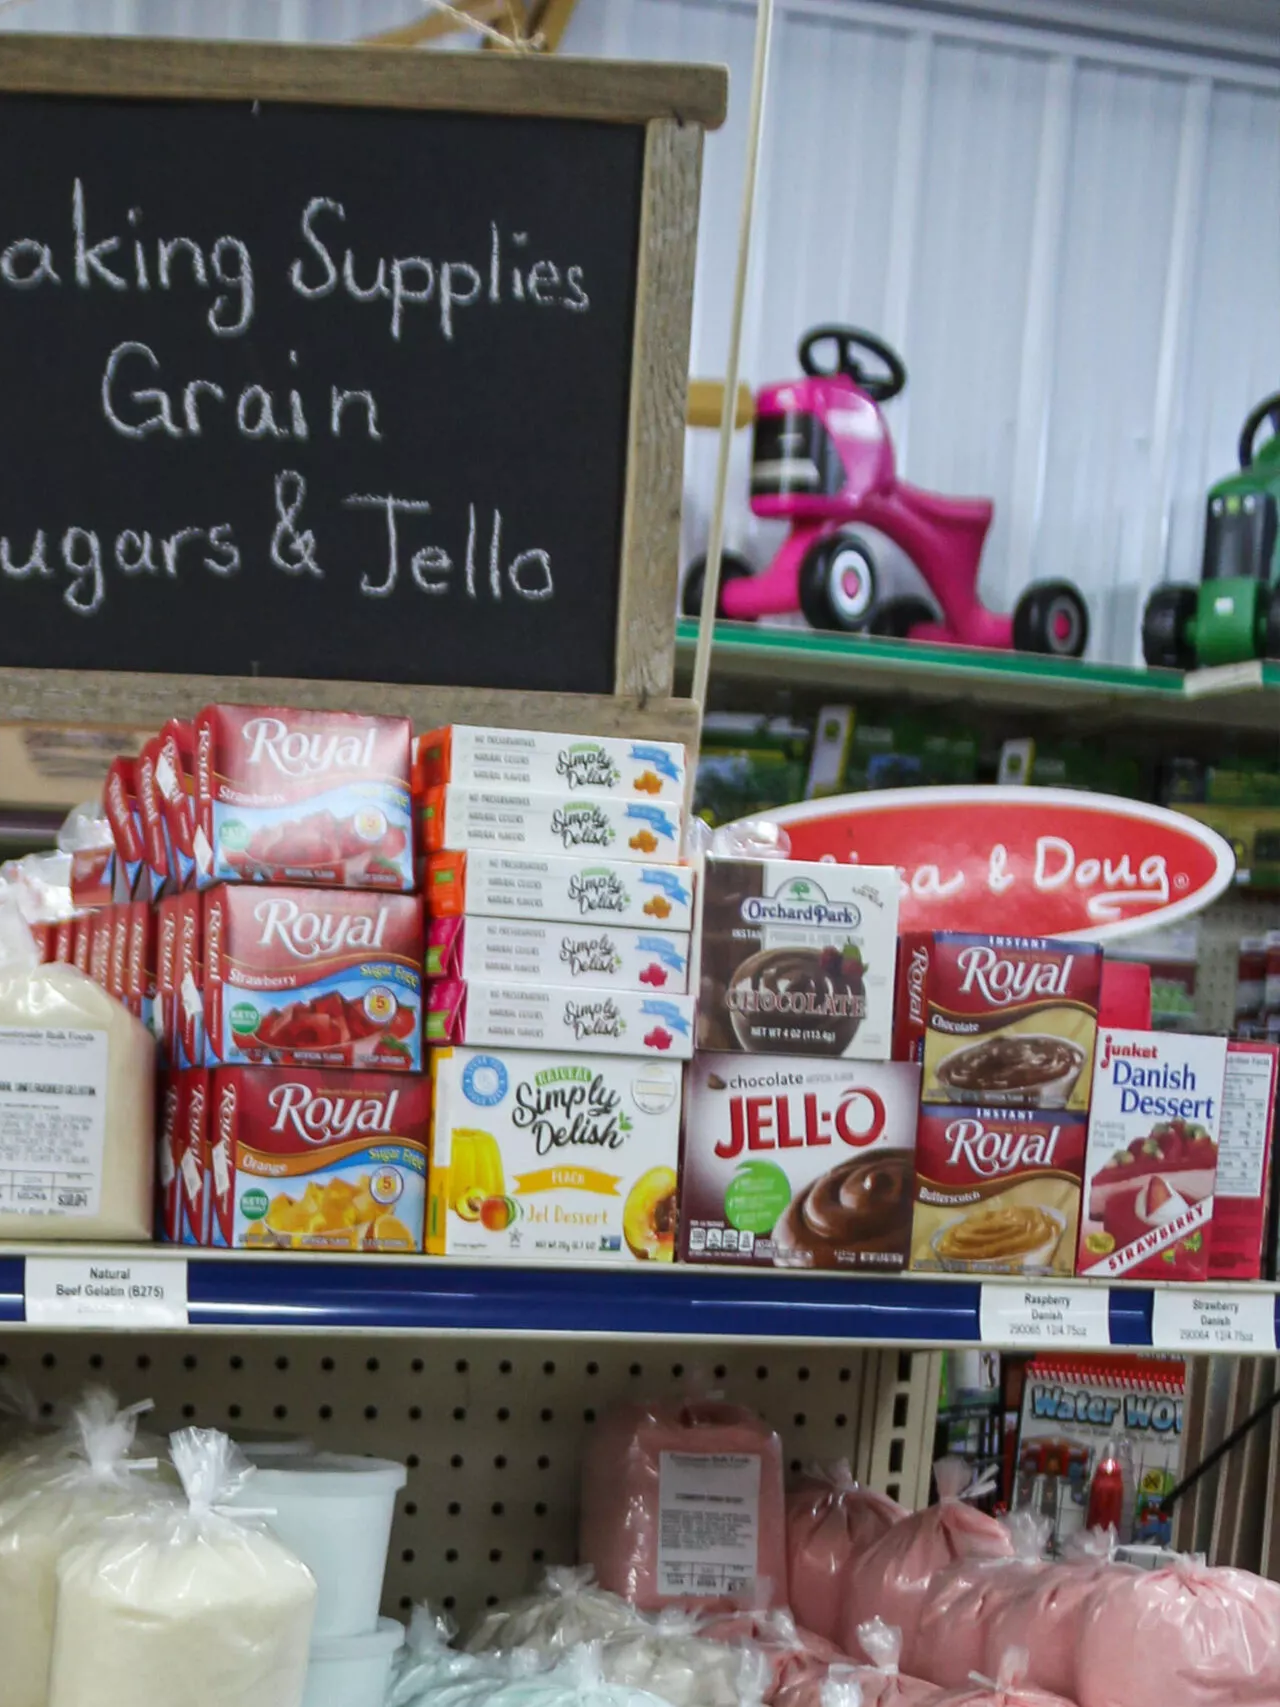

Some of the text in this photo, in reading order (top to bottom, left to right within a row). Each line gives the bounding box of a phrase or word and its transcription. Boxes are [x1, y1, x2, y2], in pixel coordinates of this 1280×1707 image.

[290, 196, 589, 342] Supplies
[102, 341, 383, 439] Grain
[271, 469, 324, 577] &
[342, 494, 553, 600] Jello
[241, 717, 377, 778] Royal
[556, 747, 612, 774] Simply
[570, 768, 616, 789] Delish
[551, 805, 609, 835] Simply
[563, 827, 611, 849] Delish
[568, 872, 624, 903] Simply
[989, 843, 1015, 890] &
[1036, 835, 1169, 920] Doug
[580, 893, 626, 914] Delish
[747, 900, 853, 928] Orchard Park
[254, 898, 389, 960] Royal
[989, 935, 1047, 950] INSTANT
[560, 933, 616, 962] Simply
[228, 967, 297, 987] Strawberry
[571, 954, 617, 977] Delish
[958, 946, 1074, 1006] Royal
[907, 946, 930, 1025] Royal
[375, 994, 386, 1008] 5
[563, 998, 619, 1026] Simply
[725, 988, 867, 1019] CHOCOLATE
[575, 1019, 621, 1041] Delish
[931, 1014, 980, 1033] Chocolate
[1100, 1034, 1159, 1069] junket
[535, 1066, 592, 1086] NATURAL
[729, 1072, 804, 1089] chocolate
[1112, 1059, 1197, 1091] Danish
[268, 1082, 400, 1144] Royal
[512, 1073, 621, 1129] Simply
[976, 1107, 1035, 1121] INSTANT
[1120, 1088, 1214, 1120] Dessert
[532, 1110, 624, 1156] Delish
[714, 1086, 887, 1159] JELL-O
[369, 1148, 425, 1171] Sugar Free
[945, 1118, 1061, 1177] Royal
[242, 1155, 288, 1175] Orange
[551, 1170, 586, 1185] PEACH
[383, 1176, 392, 1189] 5
[919, 1186, 981, 1204] Butterscotch
[527, 1204, 609, 1225] Jel Dessert
[1108, 1202, 1205, 1271] STRAWBERRY
[89, 1267, 131, 1280] Natural
[56, 1284, 165, 1299] Beef Gelatin (B275)
[1024, 1293, 1071, 1308] Raspberry
[1031, 1309, 1063, 1320] Danish
[1193, 1299, 1240, 1315] Strawberry
[1200, 1315, 1232, 1326] Danish
[1032, 1384, 1121, 1427] Water
